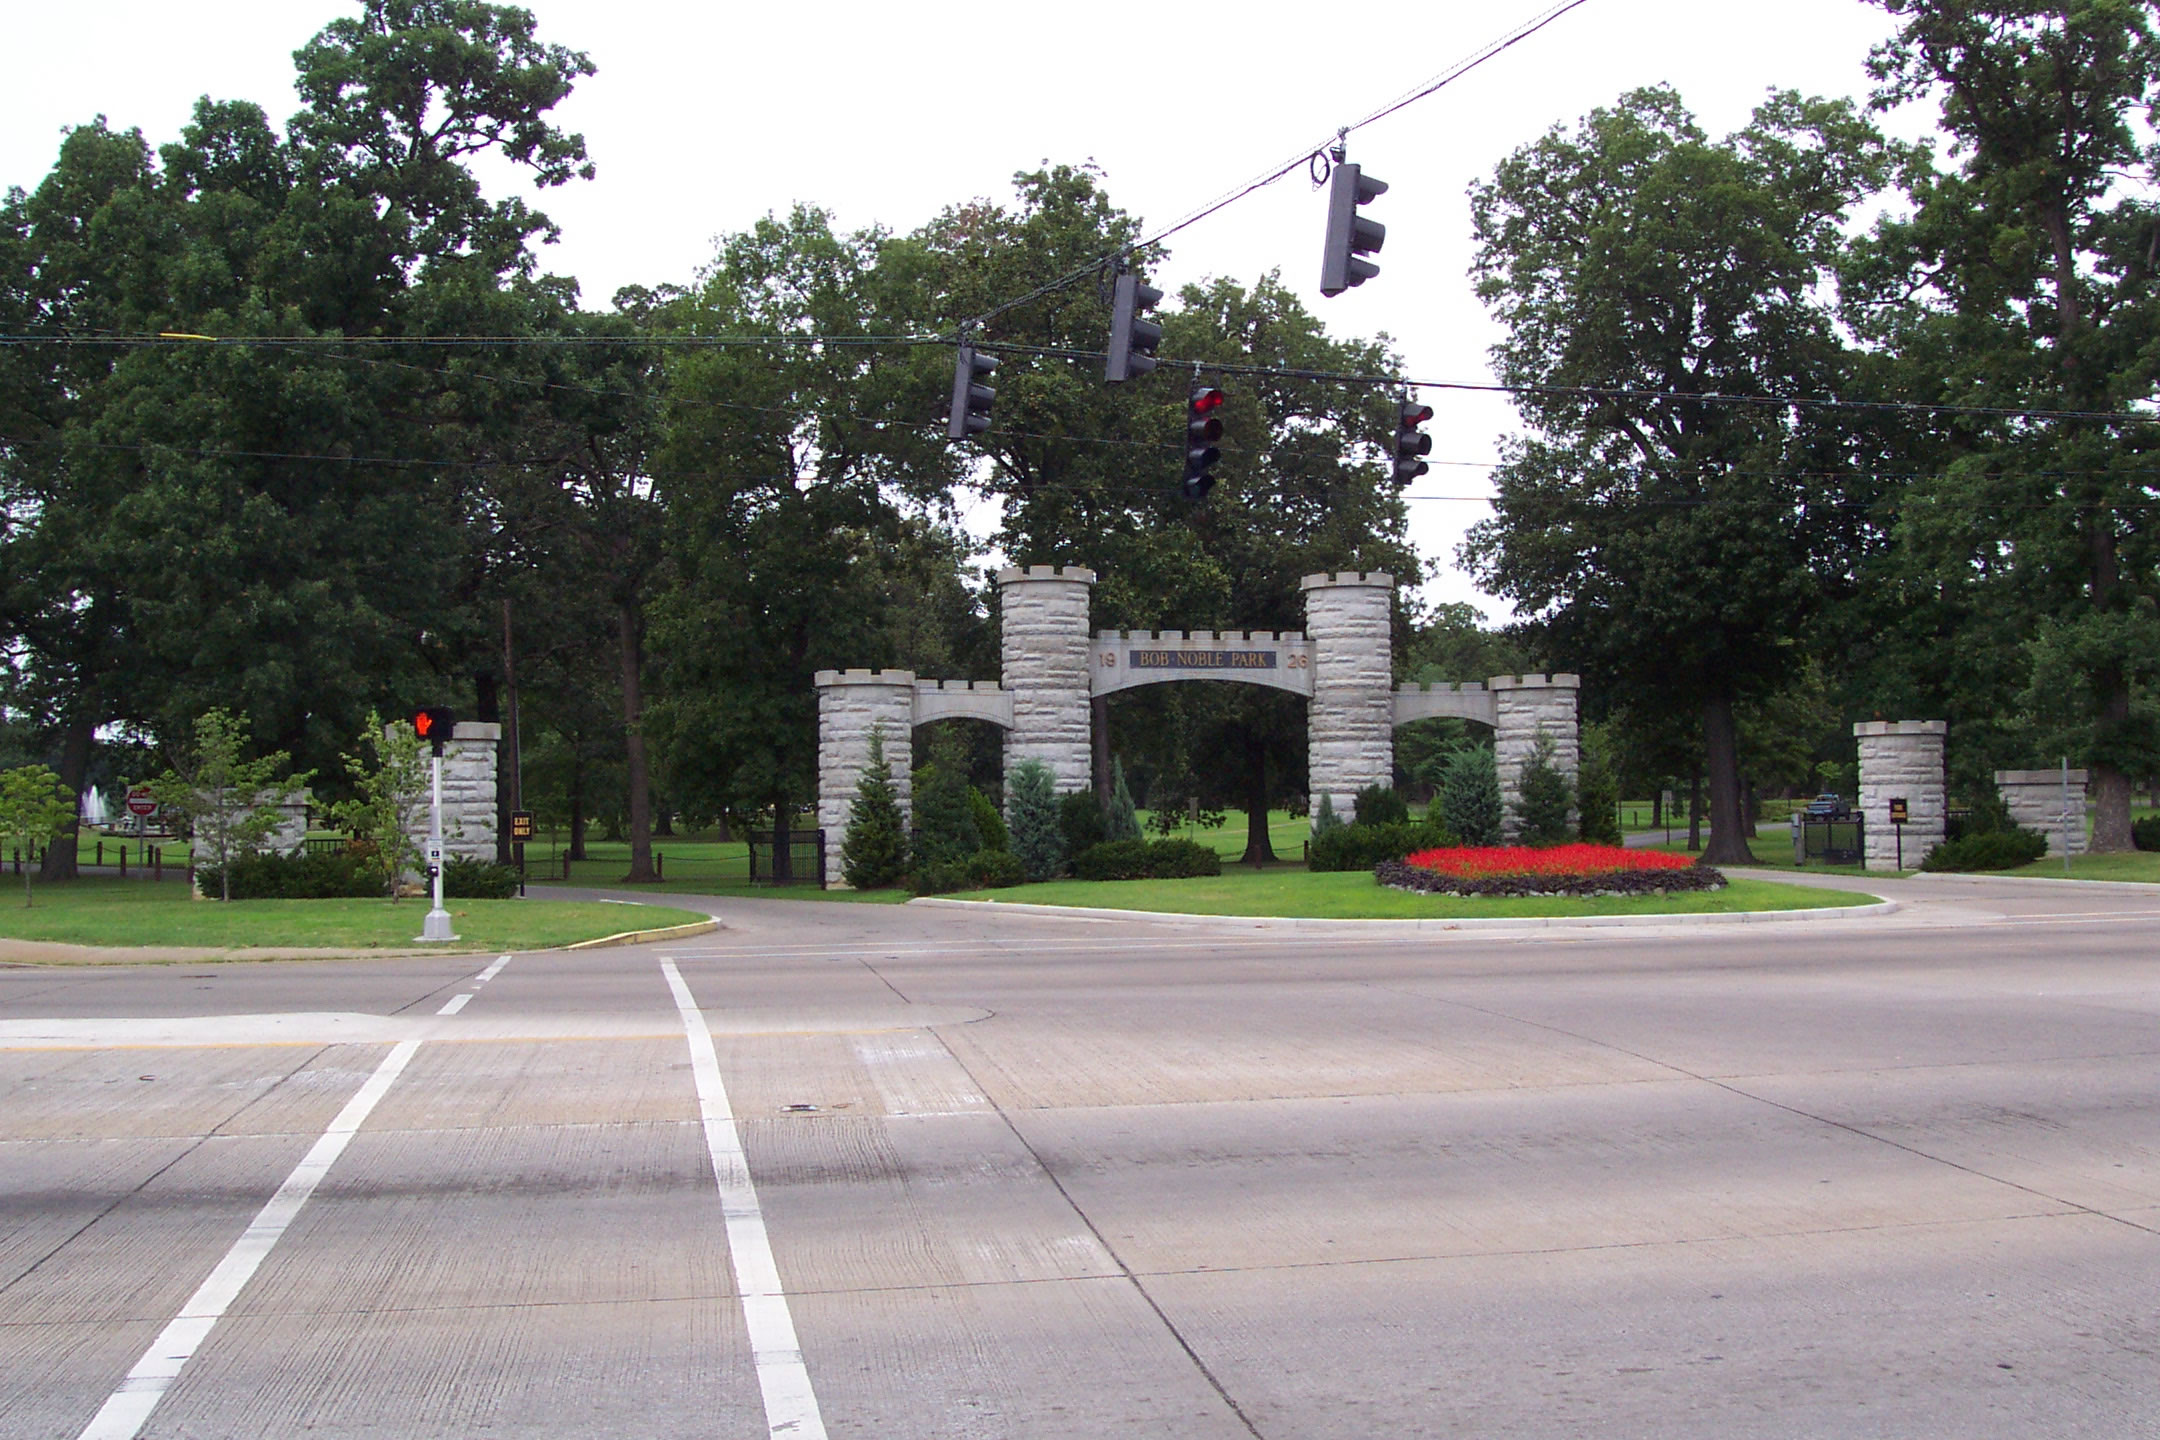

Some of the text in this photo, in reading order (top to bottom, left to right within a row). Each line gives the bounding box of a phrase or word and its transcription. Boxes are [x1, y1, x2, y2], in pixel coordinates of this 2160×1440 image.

[1140, 652, 1267, 667] BOB NOBLE PARK
